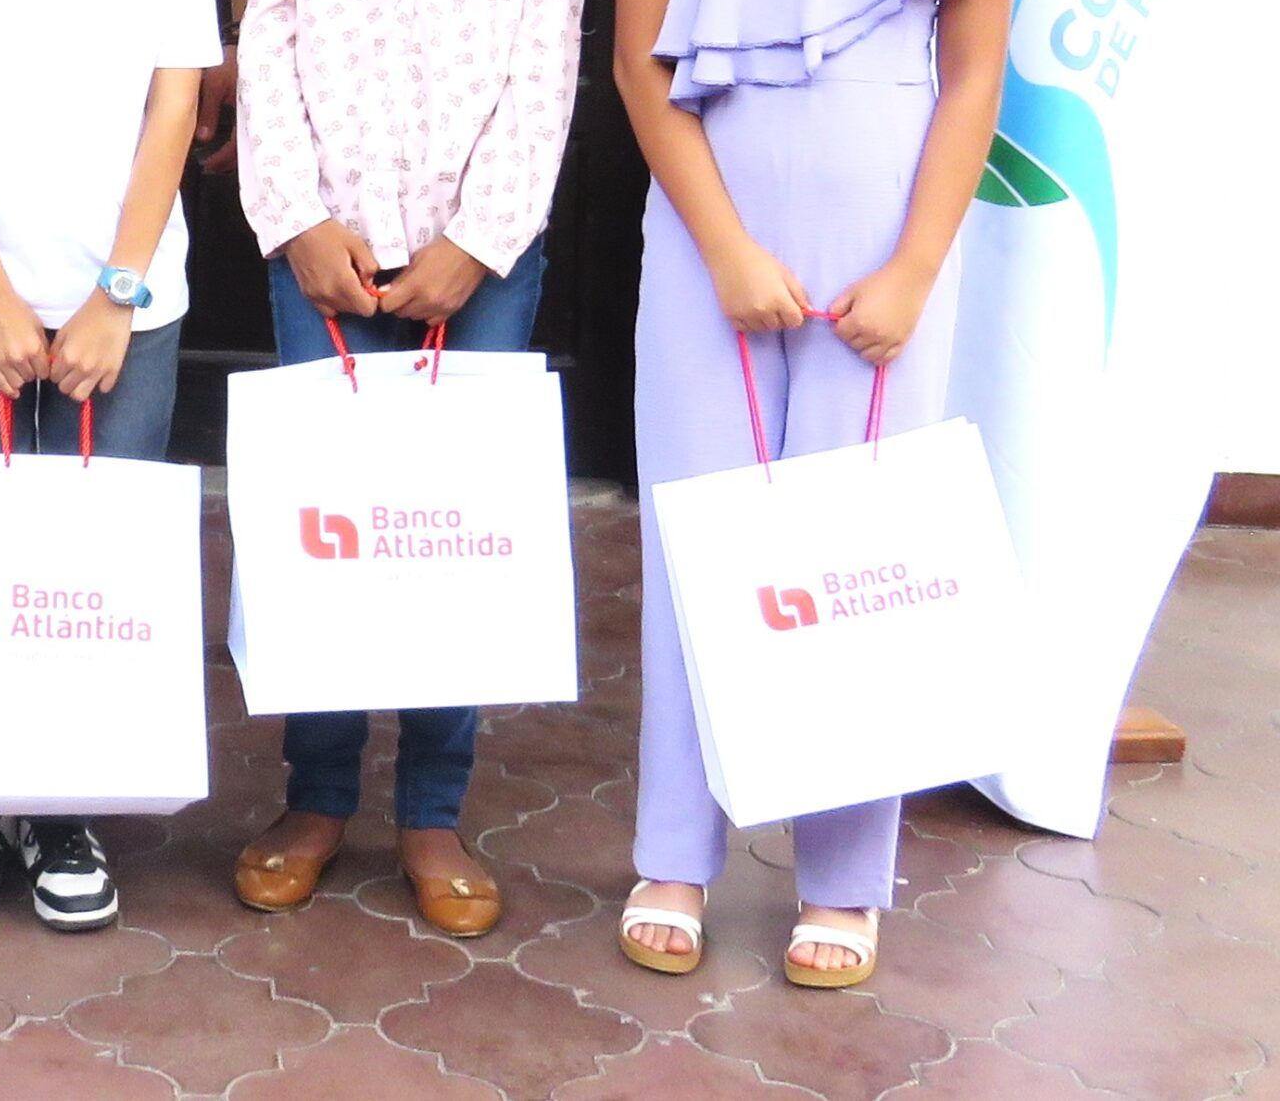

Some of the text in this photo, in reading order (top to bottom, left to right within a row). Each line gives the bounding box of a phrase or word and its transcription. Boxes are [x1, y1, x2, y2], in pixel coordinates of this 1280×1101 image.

[1095, 21, 1138, 98] DE
[372, 506, 461, 530] Banco
[823, 563, 908, 596] Banco
[12, 584, 104, 611] Banco
